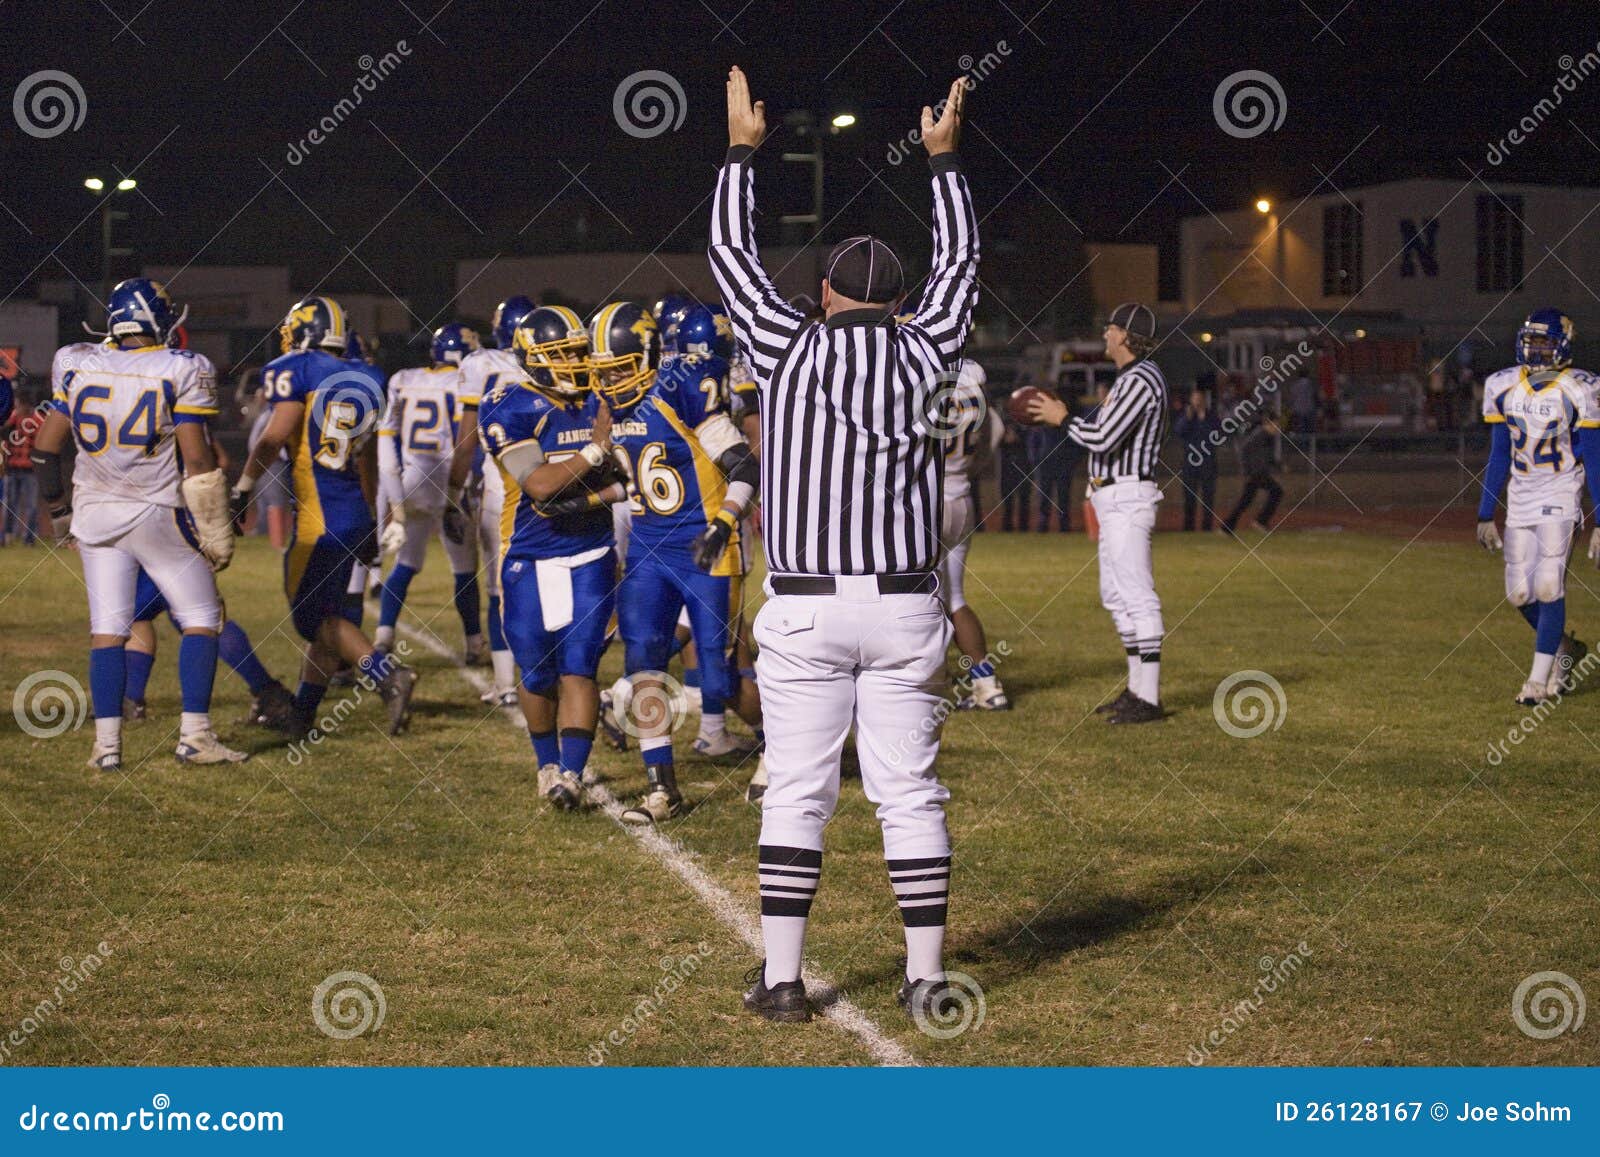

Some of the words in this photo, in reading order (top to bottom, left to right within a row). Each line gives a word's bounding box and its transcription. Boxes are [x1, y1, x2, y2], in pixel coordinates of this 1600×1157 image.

[1400, 219, 1439, 277] N
[72, 384, 164, 459] 64
[1506, 413, 1564, 474] 24
